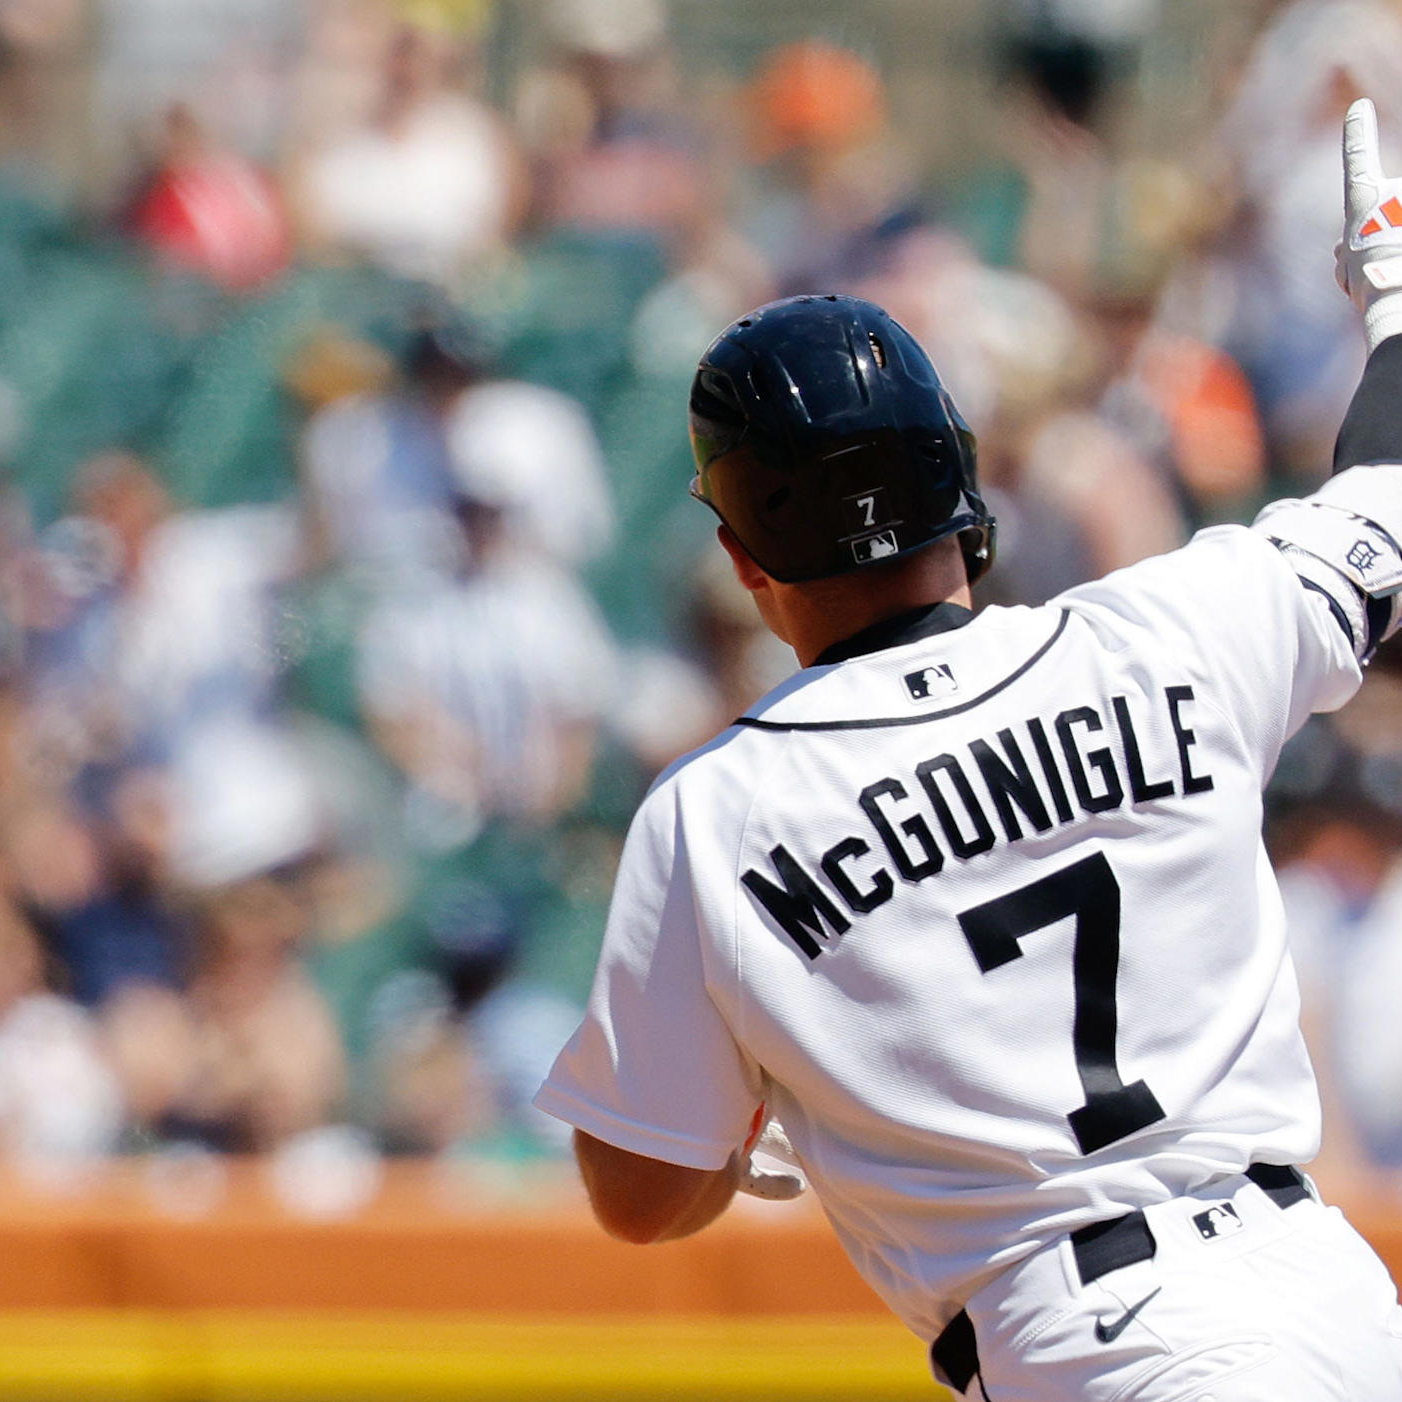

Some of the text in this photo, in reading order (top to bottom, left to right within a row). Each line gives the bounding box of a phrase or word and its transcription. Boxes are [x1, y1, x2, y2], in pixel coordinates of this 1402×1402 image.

[856, 495, 876, 526] 7
[740, 684, 1214, 961] McGONIGLE
[956, 850, 1166, 1157] 7
